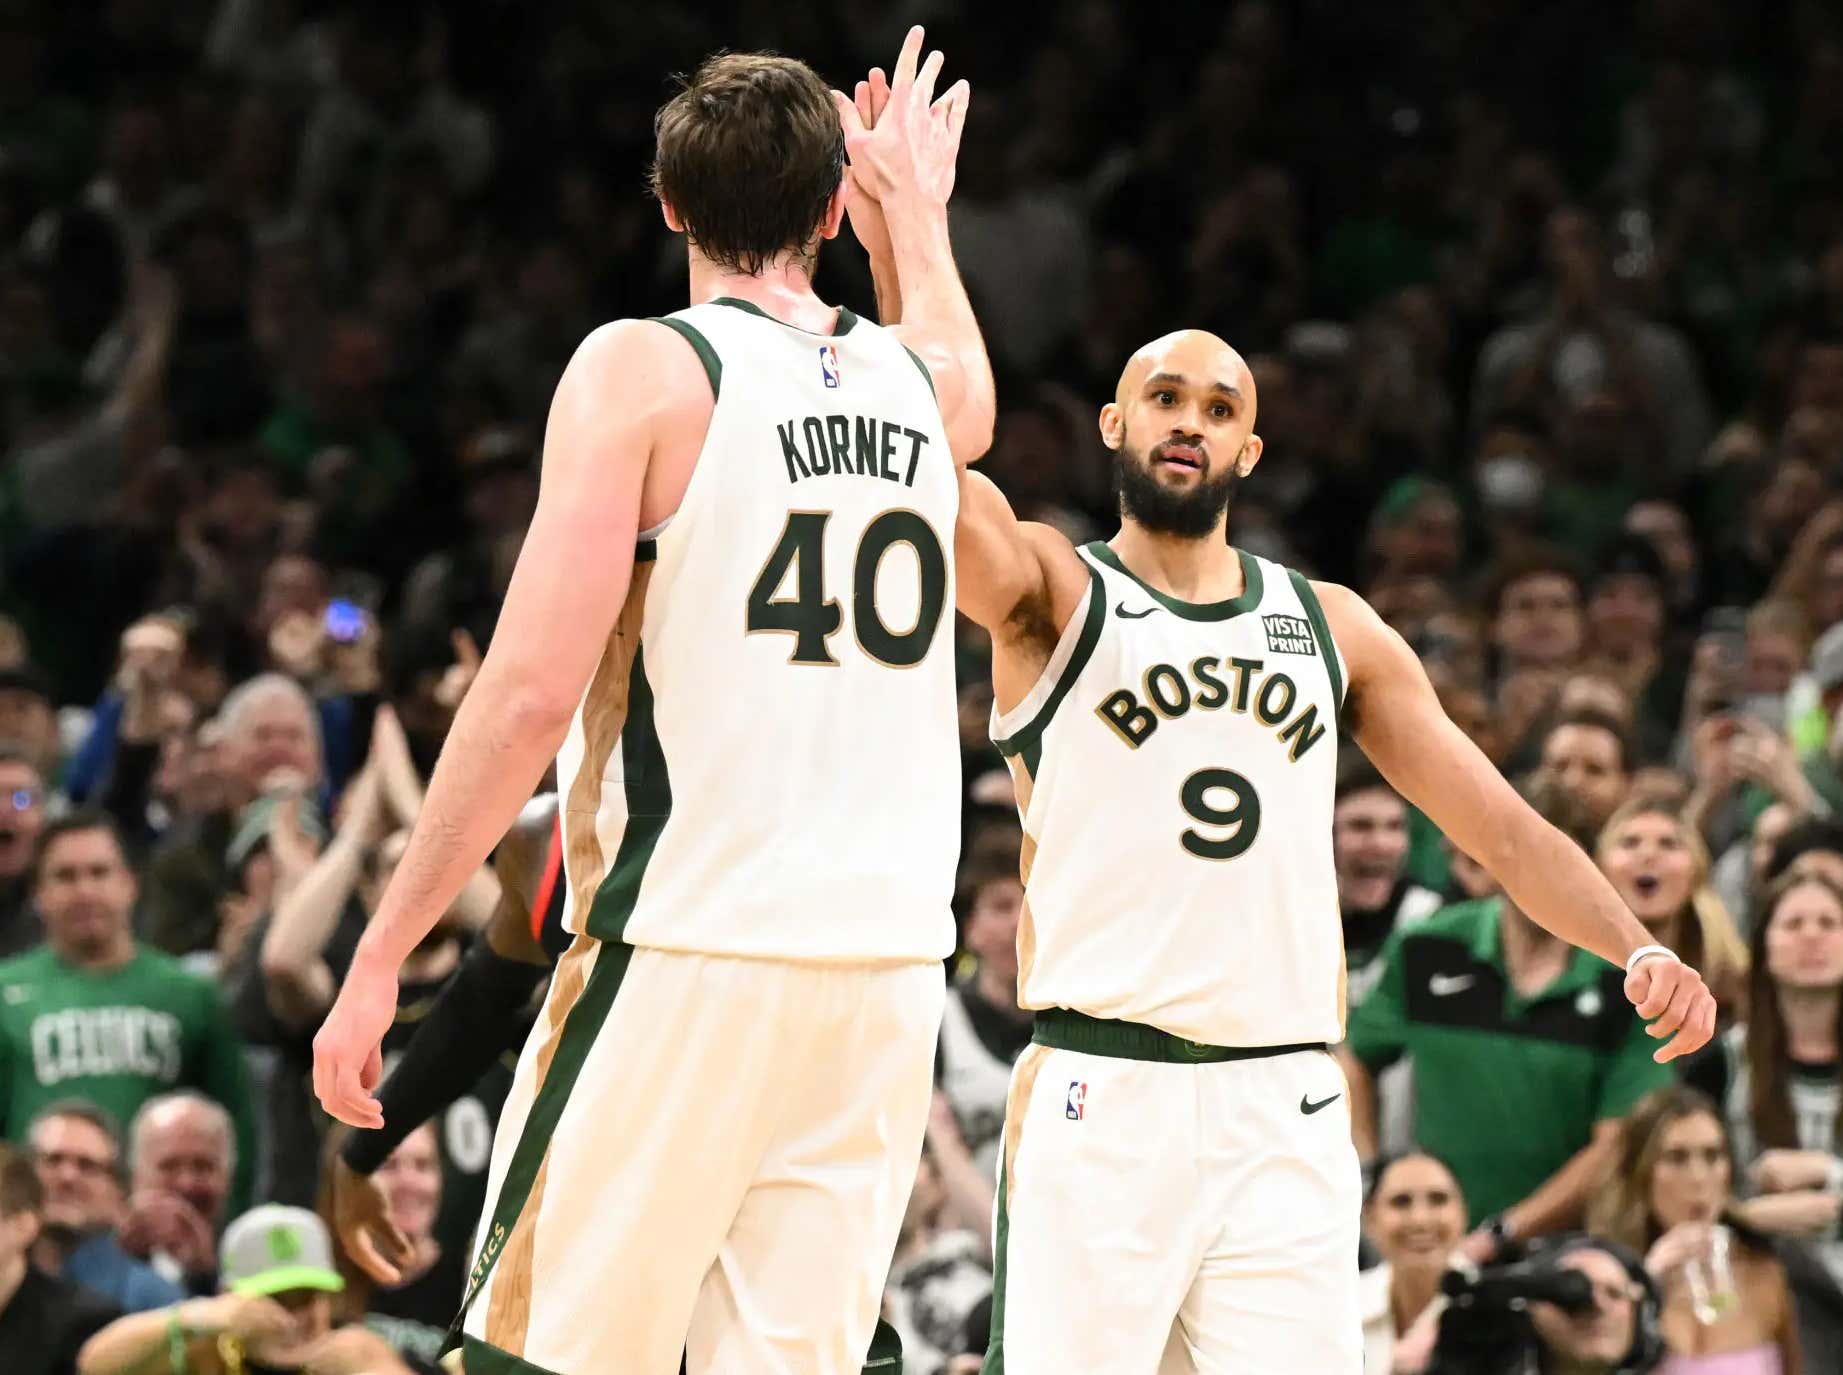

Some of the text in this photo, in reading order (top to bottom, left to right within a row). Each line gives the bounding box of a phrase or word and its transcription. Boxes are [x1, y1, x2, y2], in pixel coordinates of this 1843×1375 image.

[777, 414, 929, 487] KORNET
[744, 506, 949, 670] 40
[1263, 616, 1311, 639] VISTA
[1268, 636, 1313, 655] PRINT
[1094, 656, 1326, 763] BOSTON
[1178, 766, 1262, 862] 9
[445, 1096, 491, 1172] 0
[466, 1221, 505, 1301] LTICS
